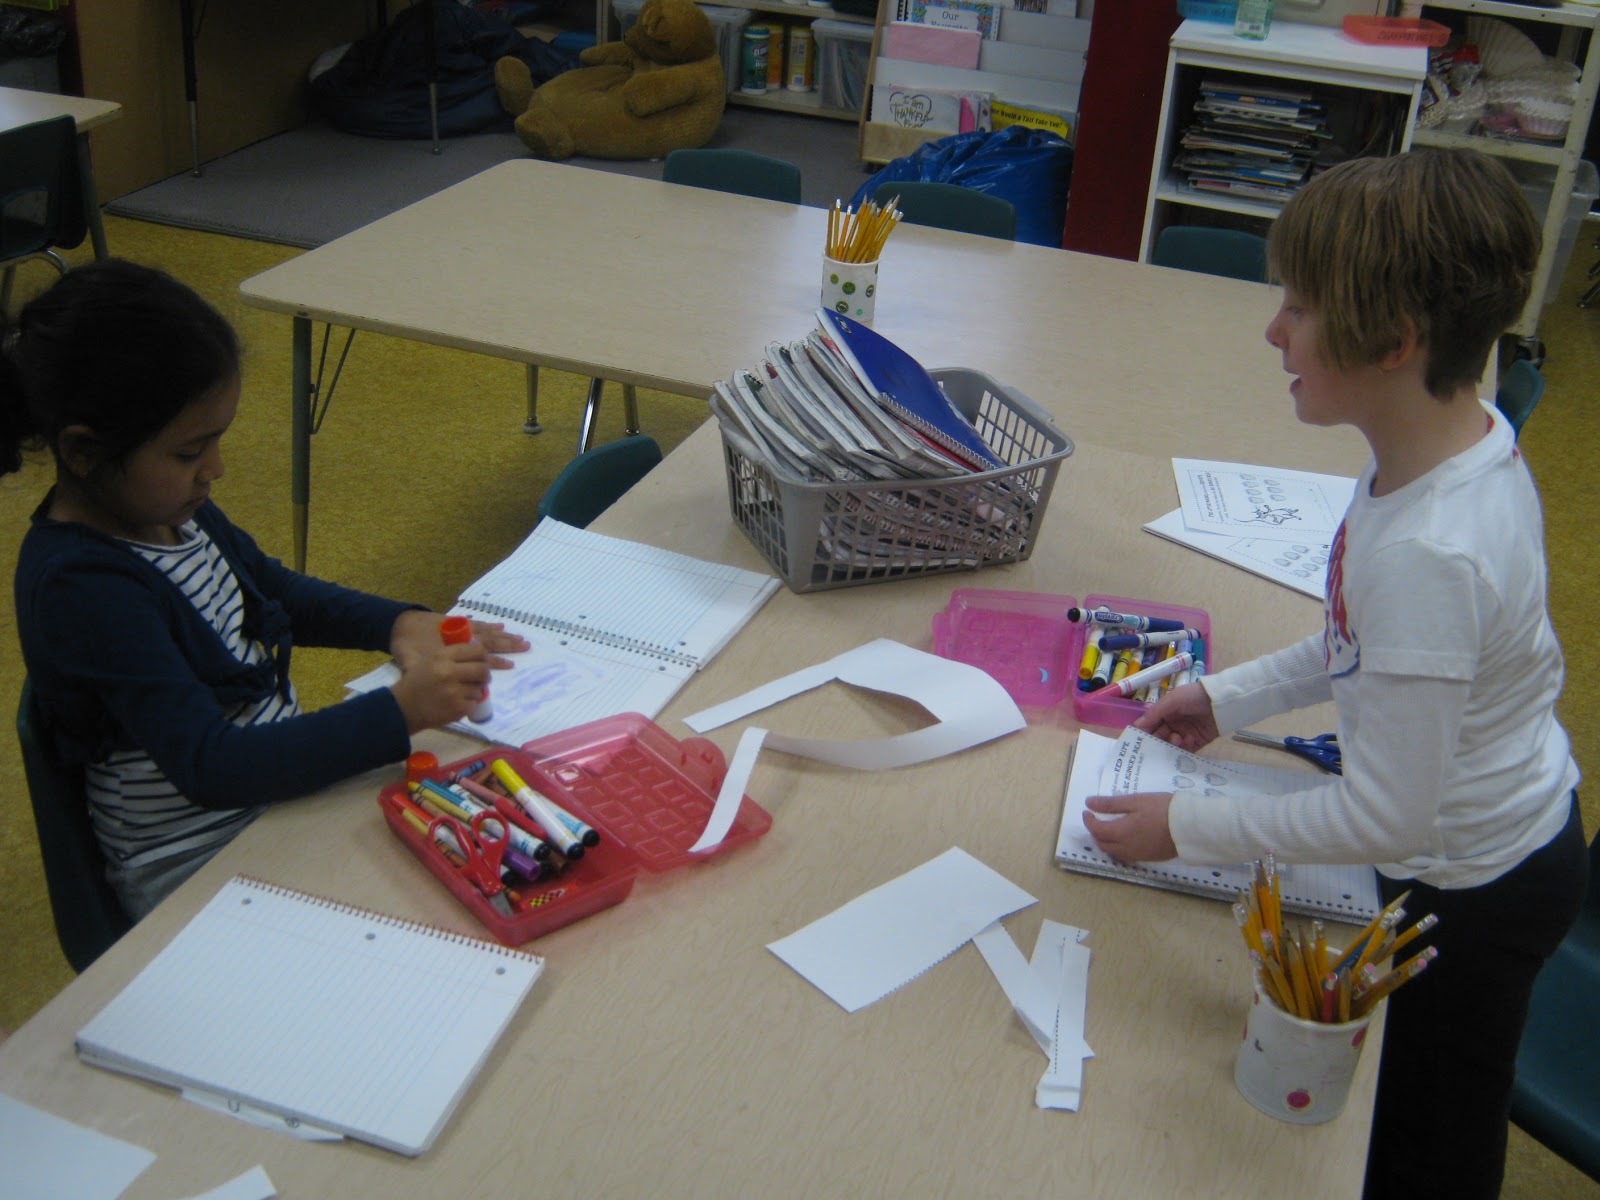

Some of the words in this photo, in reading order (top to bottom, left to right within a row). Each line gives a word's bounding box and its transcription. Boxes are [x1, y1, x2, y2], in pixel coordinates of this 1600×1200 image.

[942, 11, 959, 20] Our
[903, 95, 910, 104] I
[911, 100, 924, 110] am
[1000, 110, 1017, 119] Would
[1035, 118, 1048, 126] Take
[1097, 612, 1121, 622] Crayola
[1114, 758, 1123, 772] RED
[1119, 741, 1130, 757] RIPE
[1125, 755, 1136, 780] HUNGRY
[1132, 736, 1143, 754] BEAR
